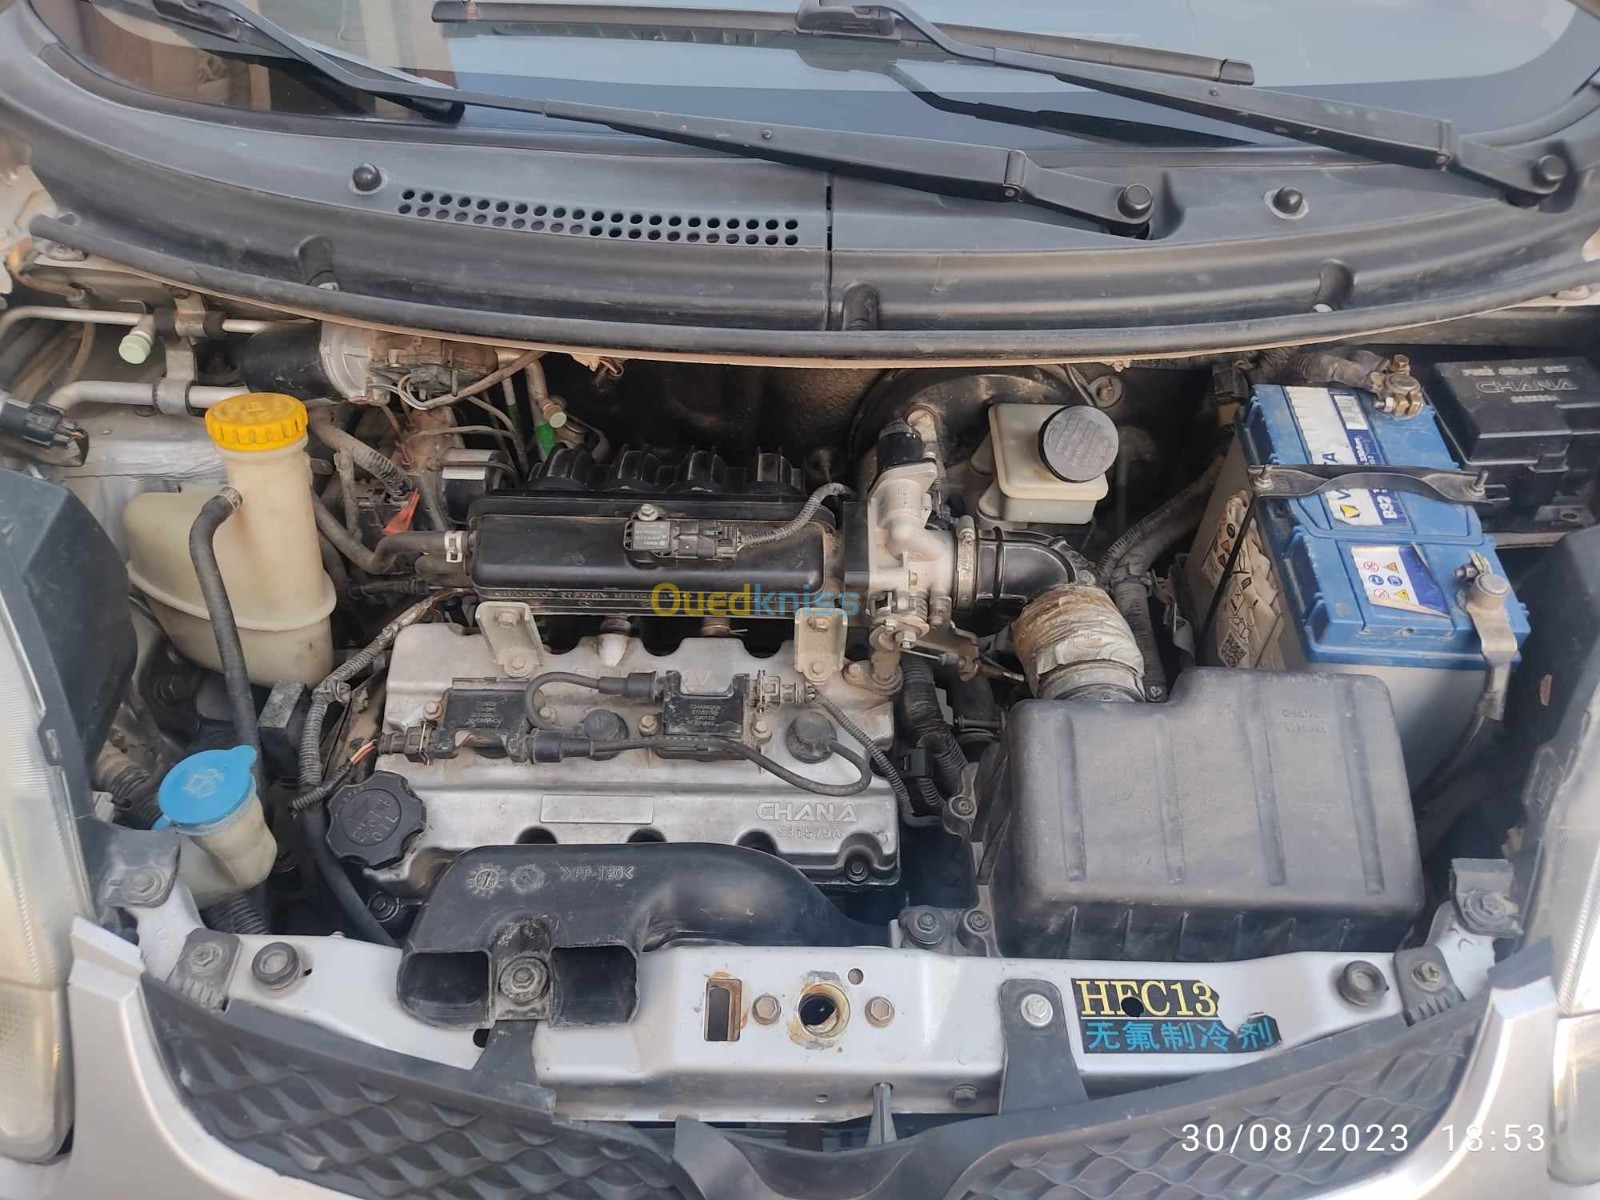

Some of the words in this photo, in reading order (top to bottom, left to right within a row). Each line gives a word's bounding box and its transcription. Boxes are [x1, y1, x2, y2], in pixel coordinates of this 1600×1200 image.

[1475, 378, 1579, 394] CHANA
[756, 801, 857, 822] CHANA
[1086, 1017, 1276, 1052] 无氟制冷剂
